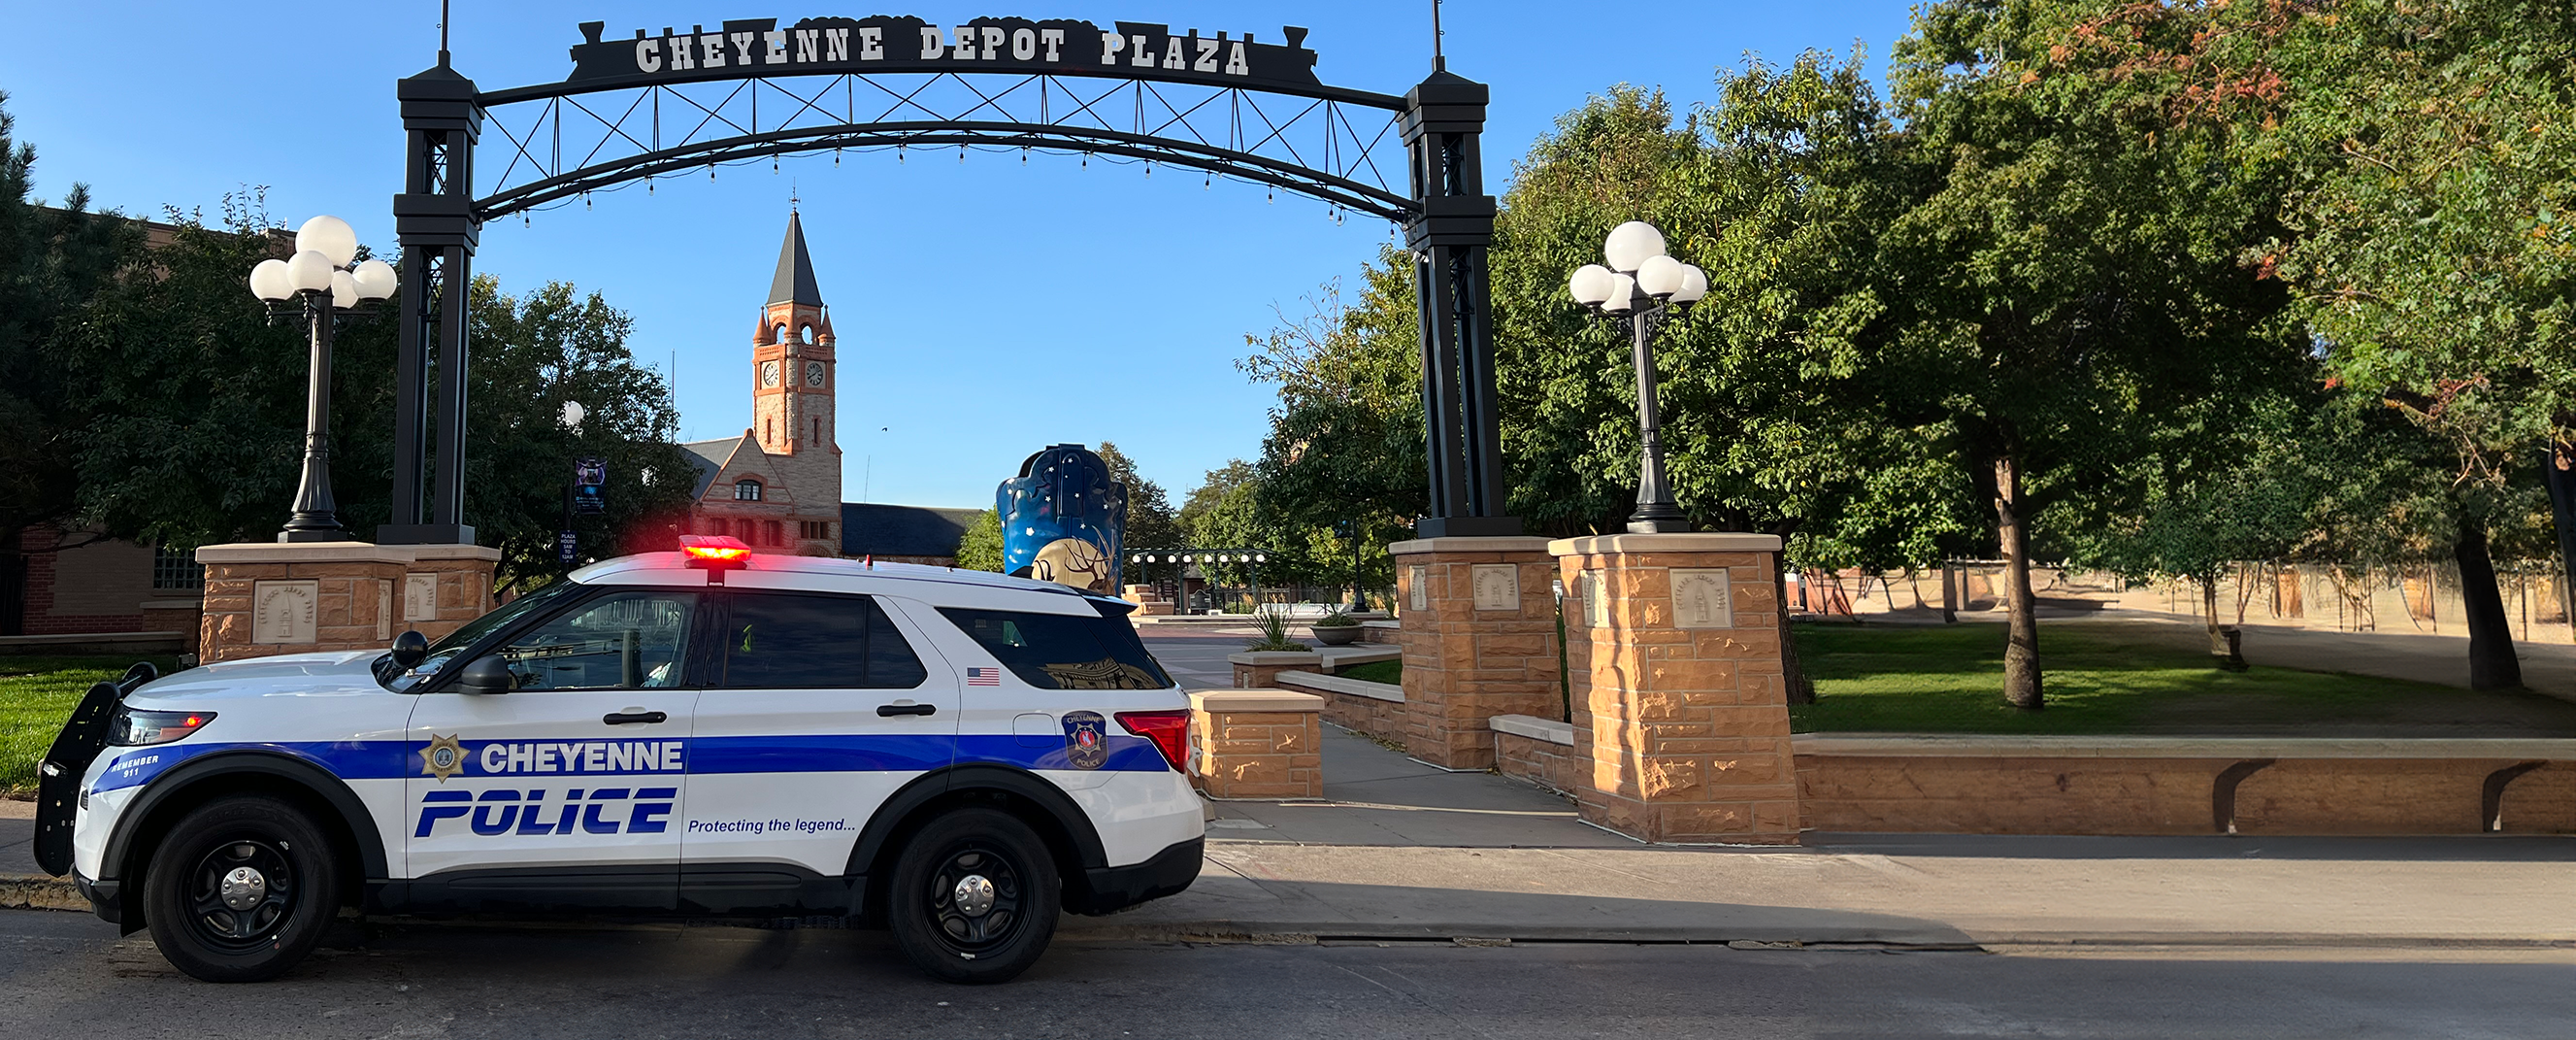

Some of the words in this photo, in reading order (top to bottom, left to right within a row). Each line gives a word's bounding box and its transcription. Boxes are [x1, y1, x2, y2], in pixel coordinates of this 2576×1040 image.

[636, 26, 884, 74] CHEYENNE
[920, 26, 1065, 63] DEPOT
[1101, 32, 1249, 76] PLAZA
[1067, 714, 1100, 724] CHEYENNE
[111, 755, 159, 773] REMEMBER
[480, 741, 683, 773] CHEYENNE
[1076, 758, 1100, 767] POLICE
[123, 767, 139, 778] 911
[413, 787, 678, 838] POLICE
[688, 819, 764, 835] Protecting
[768, 819, 791, 831] the
[795, 819, 856, 834] legend...
